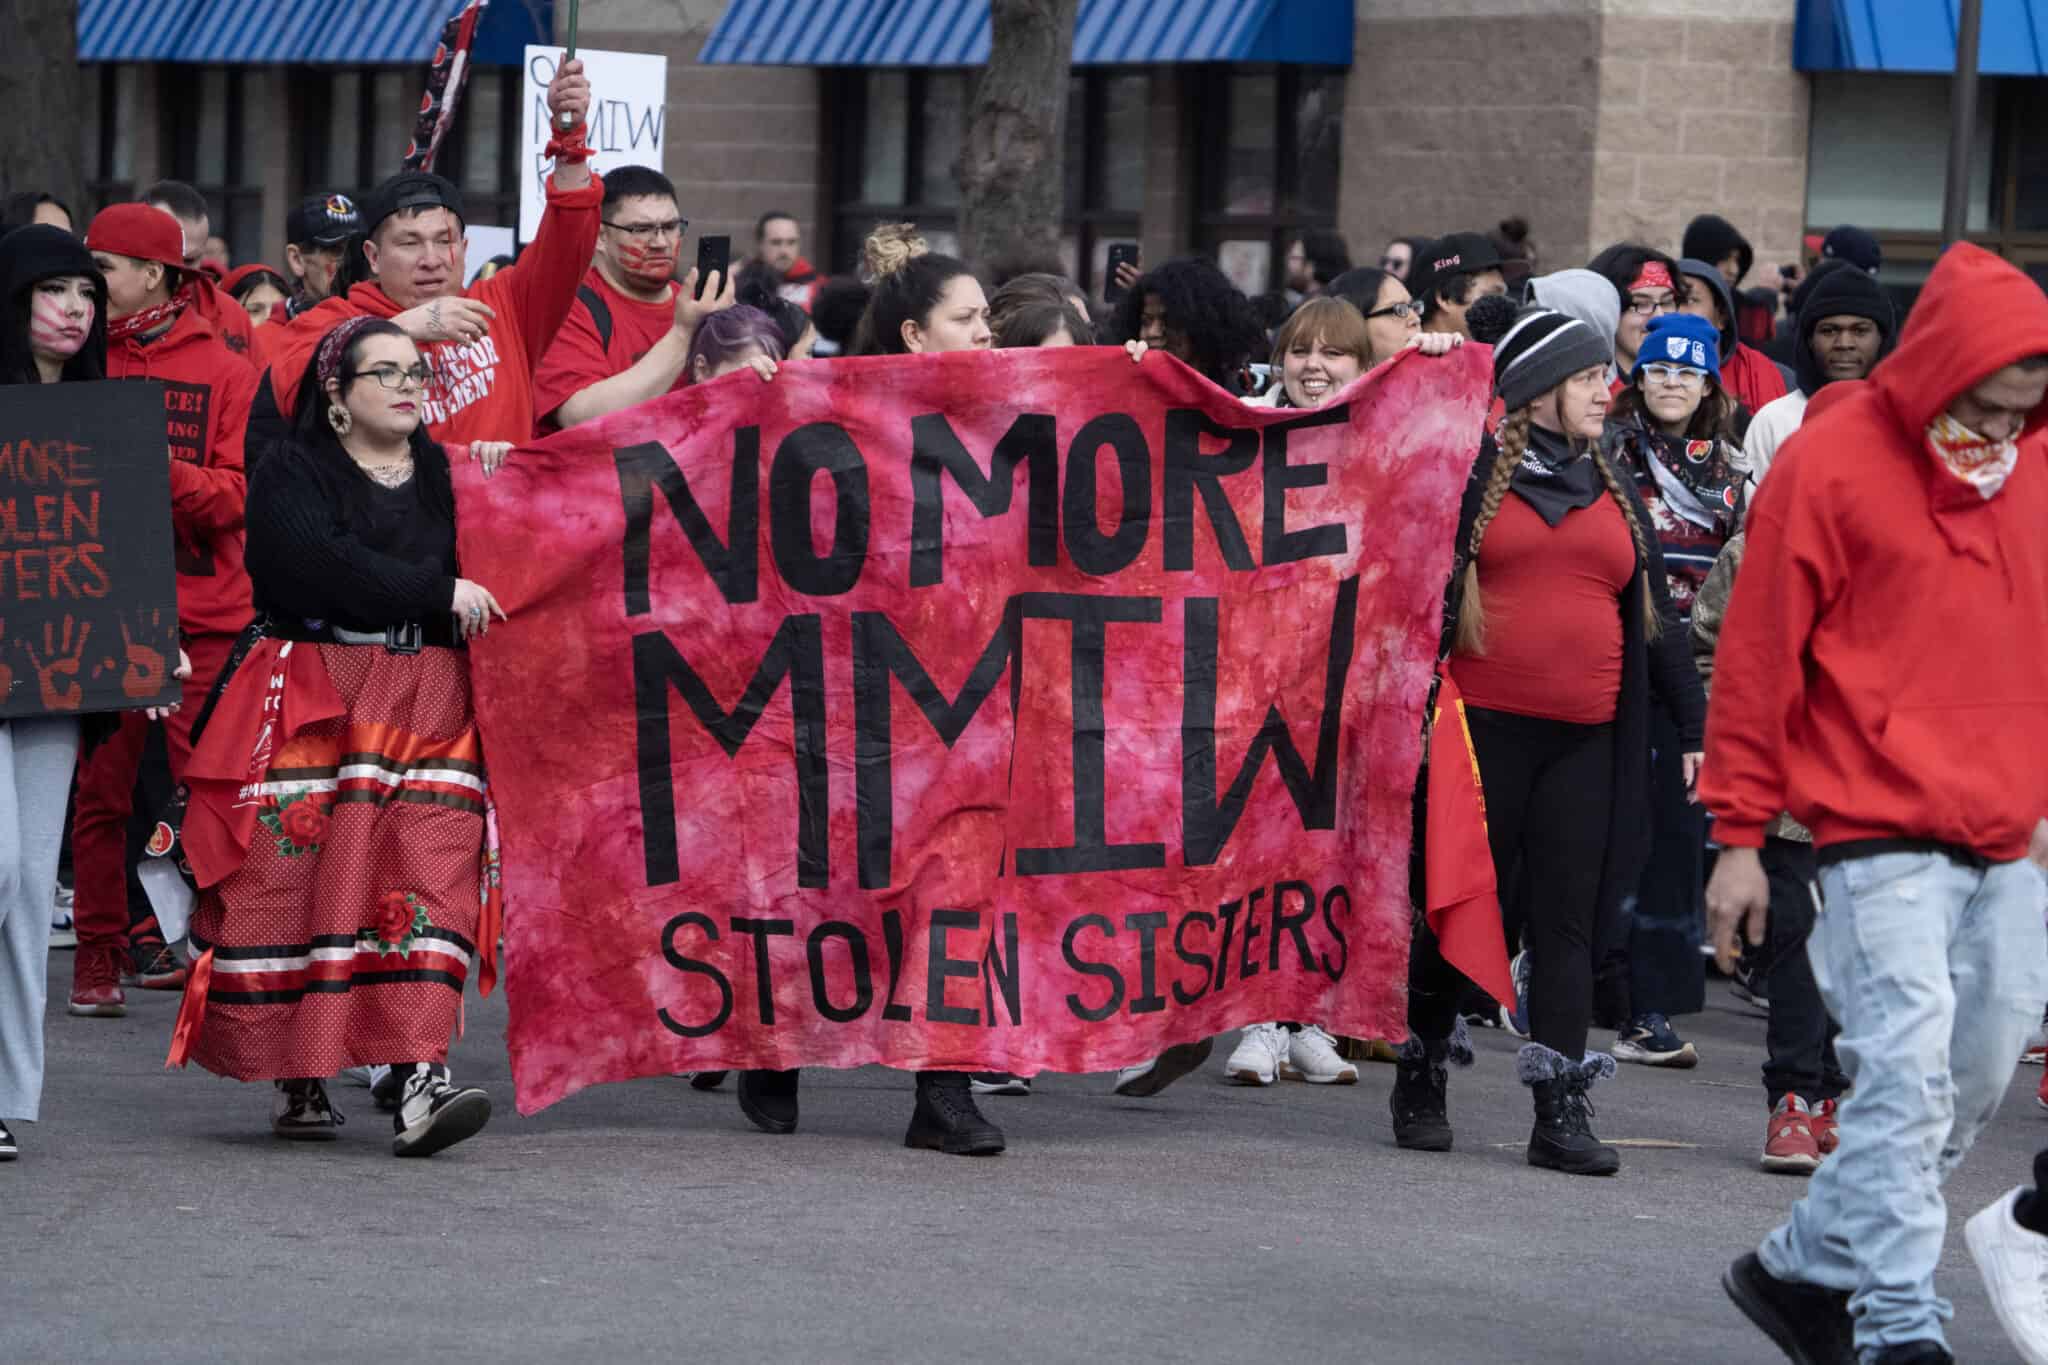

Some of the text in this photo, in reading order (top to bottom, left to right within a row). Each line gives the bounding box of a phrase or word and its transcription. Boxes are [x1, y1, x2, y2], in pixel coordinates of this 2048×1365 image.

[1433, 254, 1461, 272] King
[420, 368, 495, 424] OVEMENT
[614, 402, 1351, 617] NO MORE
[631, 573, 1361, 891] MMIW
[656, 879, 1352, 1038] STOLEN SISTERS
